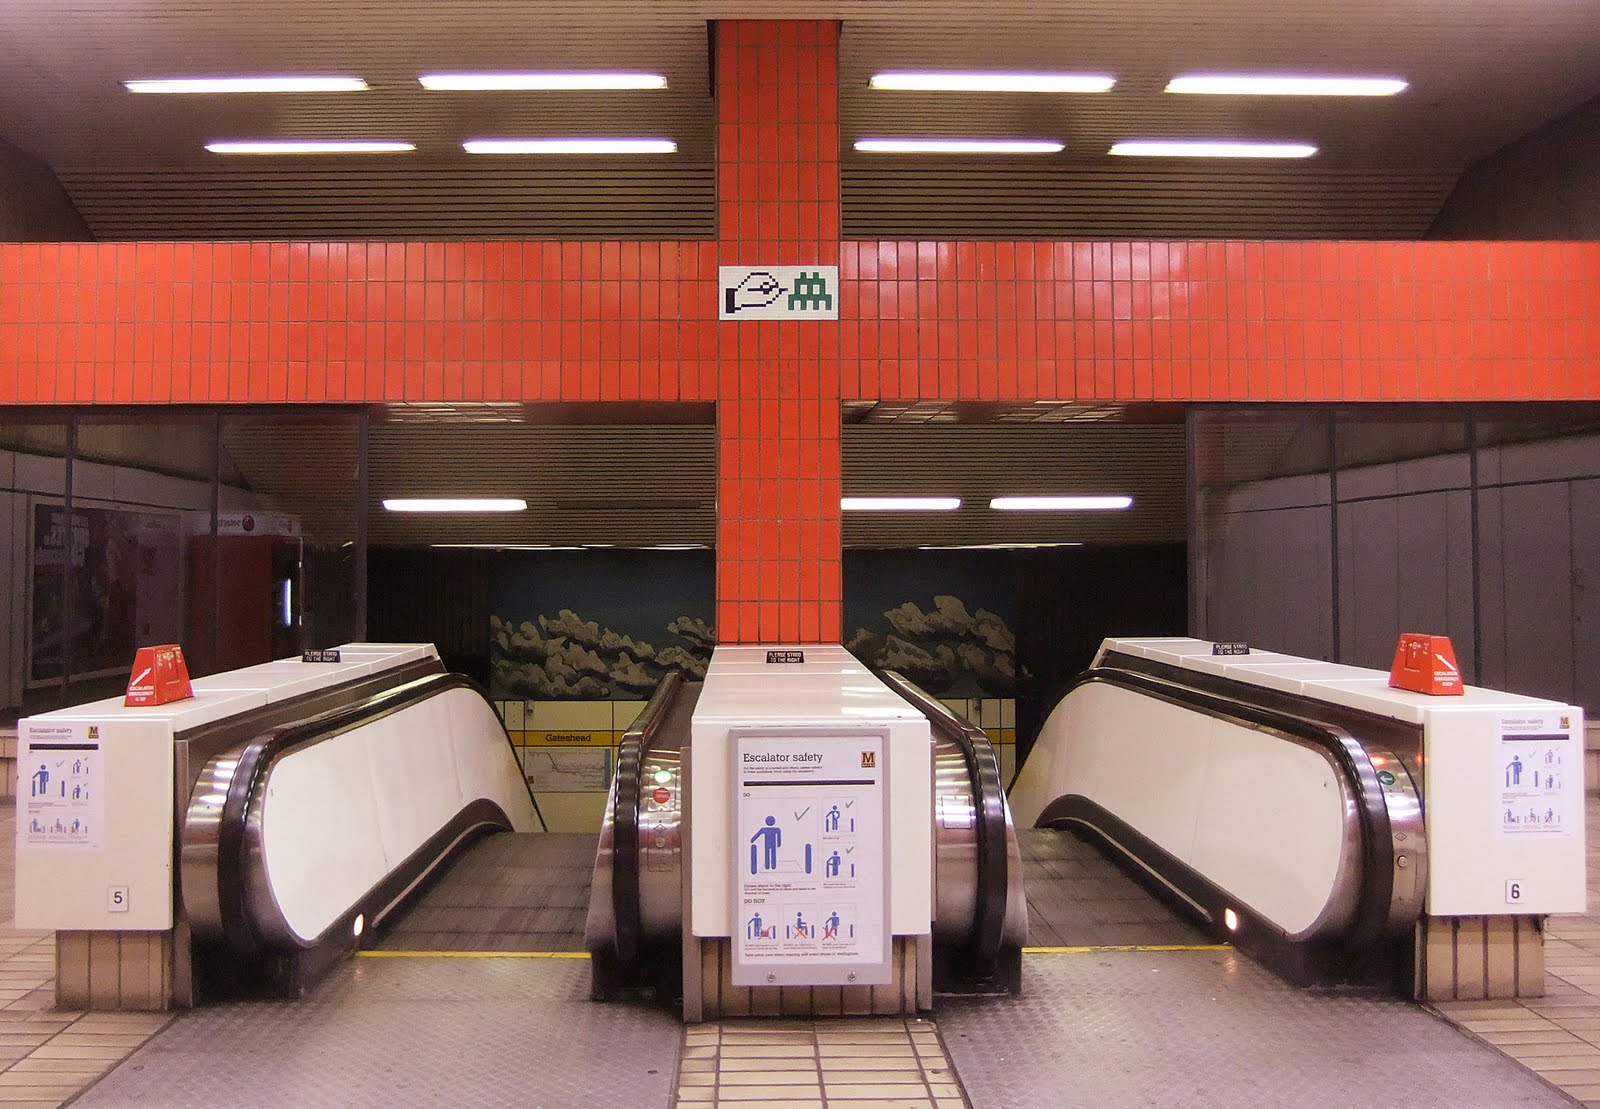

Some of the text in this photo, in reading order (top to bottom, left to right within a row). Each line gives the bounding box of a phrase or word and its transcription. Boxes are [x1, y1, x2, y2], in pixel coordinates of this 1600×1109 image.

[545, 734, 591, 742] Gateshead
[743, 752, 823, 763] Escalator safety
[114, 891, 122, 904] 5
[1511, 884, 1520, 899] 6
